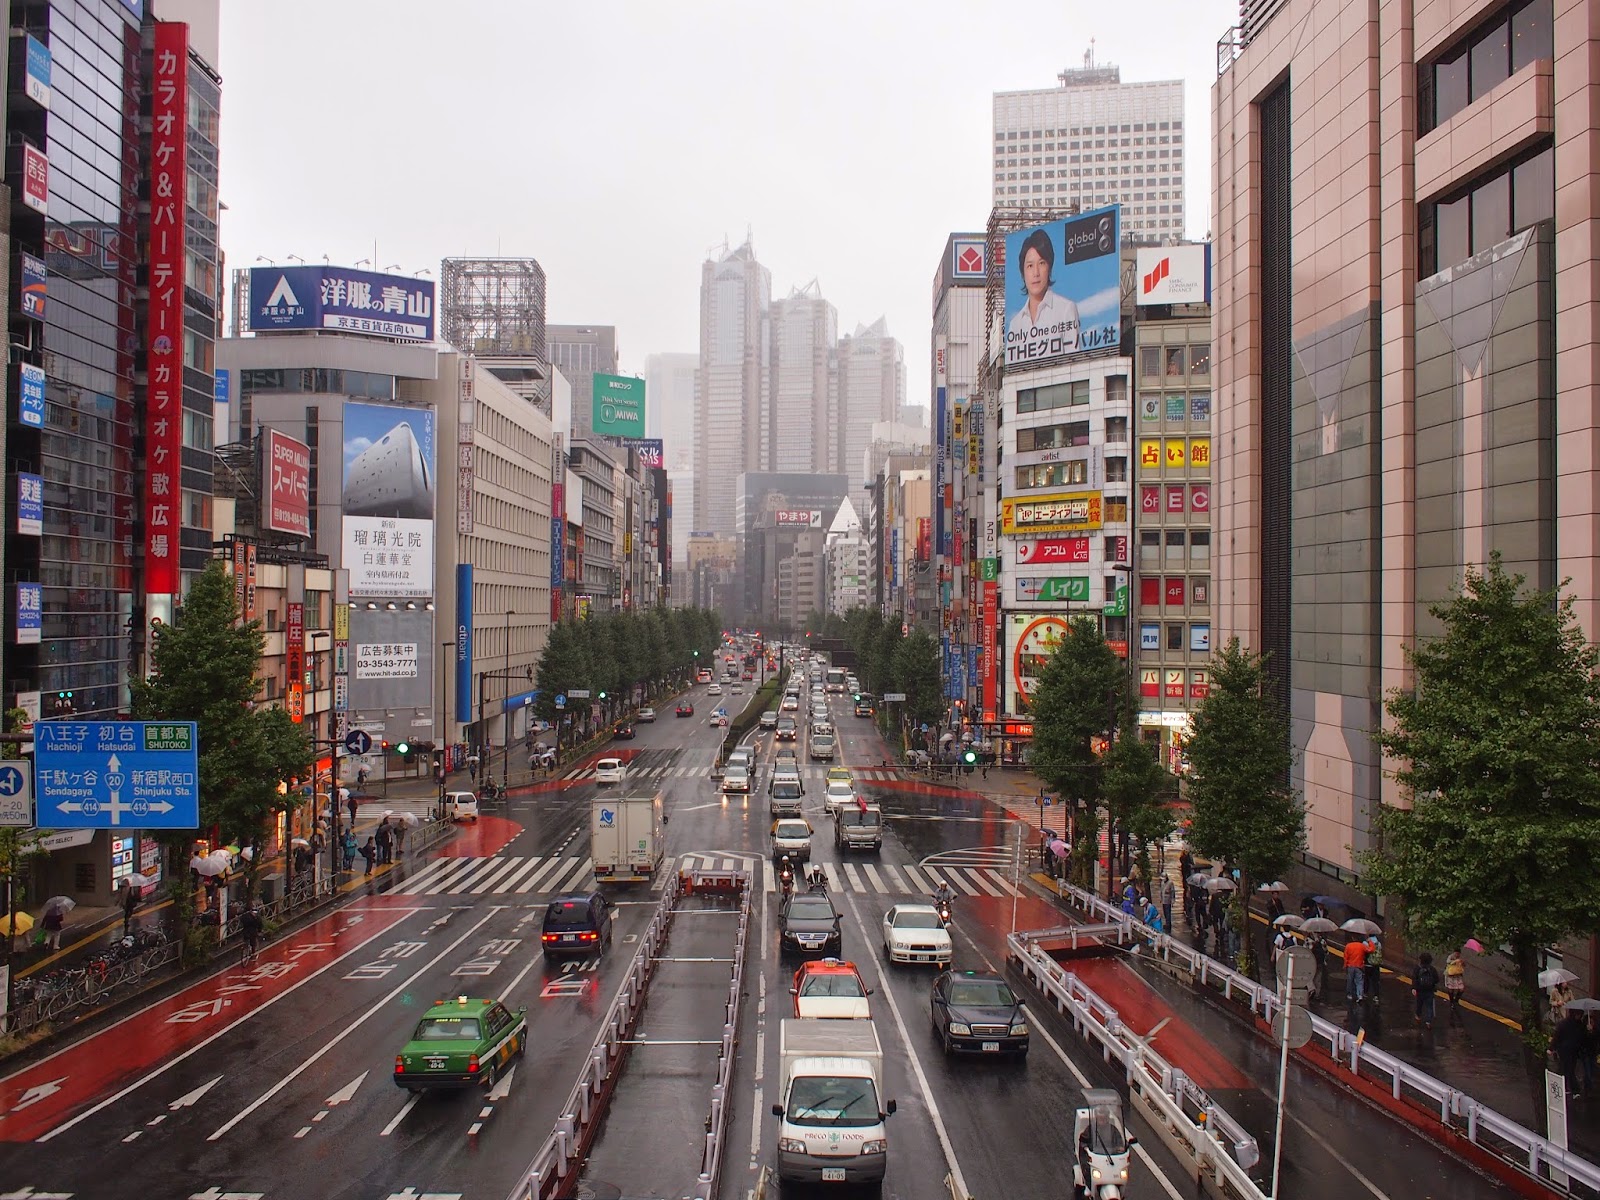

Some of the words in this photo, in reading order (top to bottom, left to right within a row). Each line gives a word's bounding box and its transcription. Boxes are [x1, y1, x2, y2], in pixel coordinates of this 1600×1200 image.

[1068, 228, 1097, 254] global
[320, 277, 430, 318] 洋服の青山
[262, 306, 304, 316] 洋服の青山
[338, 317, 415, 334] 京王百貨店向い
[1007, 328, 1028, 343] Only
[1030, 326, 1050, 337] One
[1050, 319, 1081, 334] の住まい
[1007, 326, 1116, 362] THEグローバル社
[25, 366, 43, 384] AEON
[24, 382, 42, 398] 英会話
[615, 410, 638, 421] MIWA
[275, 443, 293, 464] SUPER
[1041, 451, 1060, 461] artist
[1143, 445, 1209, 464] 占い館
[20, 478, 42, 503] 東進
[779, 512, 808, 521] やまや
[1035, 508, 1088, 520] エーアイアール
[1088, 497, 1100, 523] 賃貸
[381, 520, 396, 529] 新宿
[986, 521, 994, 541] アコム
[354, 529, 421, 547] 瑠璃光院
[1075, 540, 1085, 550] 6F
[1043, 545, 1067, 556] アコム
[1118, 538, 1126, 560] アコム
[363, 552, 412, 566] 白蓮華堂
[1050, 580, 1083, 597] レイク
[1168, 588, 1181, 596] 4F
[20, 588, 40, 610] 東進
[289, 608, 302, 640] 指圧
[361, 645, 413, 657] 広告募集中
[459, 625, 468, 661] citibank
[357, 659, 417, 668] 03-3543-7771
[1166, 687, 1183, 695] 新宿
[39, 725, 90, 741] 八王子
[98, 725, 135, 742] 初台
[145, 726, 190, 741] 首都高
[46, 742, 83, 752] Hachioji
[97, 742, 136, 751] Hatsudai
[148, 741, 187, 749] SHUTOKO
[109, 776, 121, 786] 20
[131, 770, 193, 785] 新宿駅西口
[44, 787, 93, 798] Sendagaya
[133, 787, 172, 798] Shinjuku
[175, 787, 192, 796] Sta.
[83, 803, 98, 811] 414
[133, 803, 147, 811] 414
[55, 836, 73, 844] SELECT
[341, 941, 428, 979] 初台
